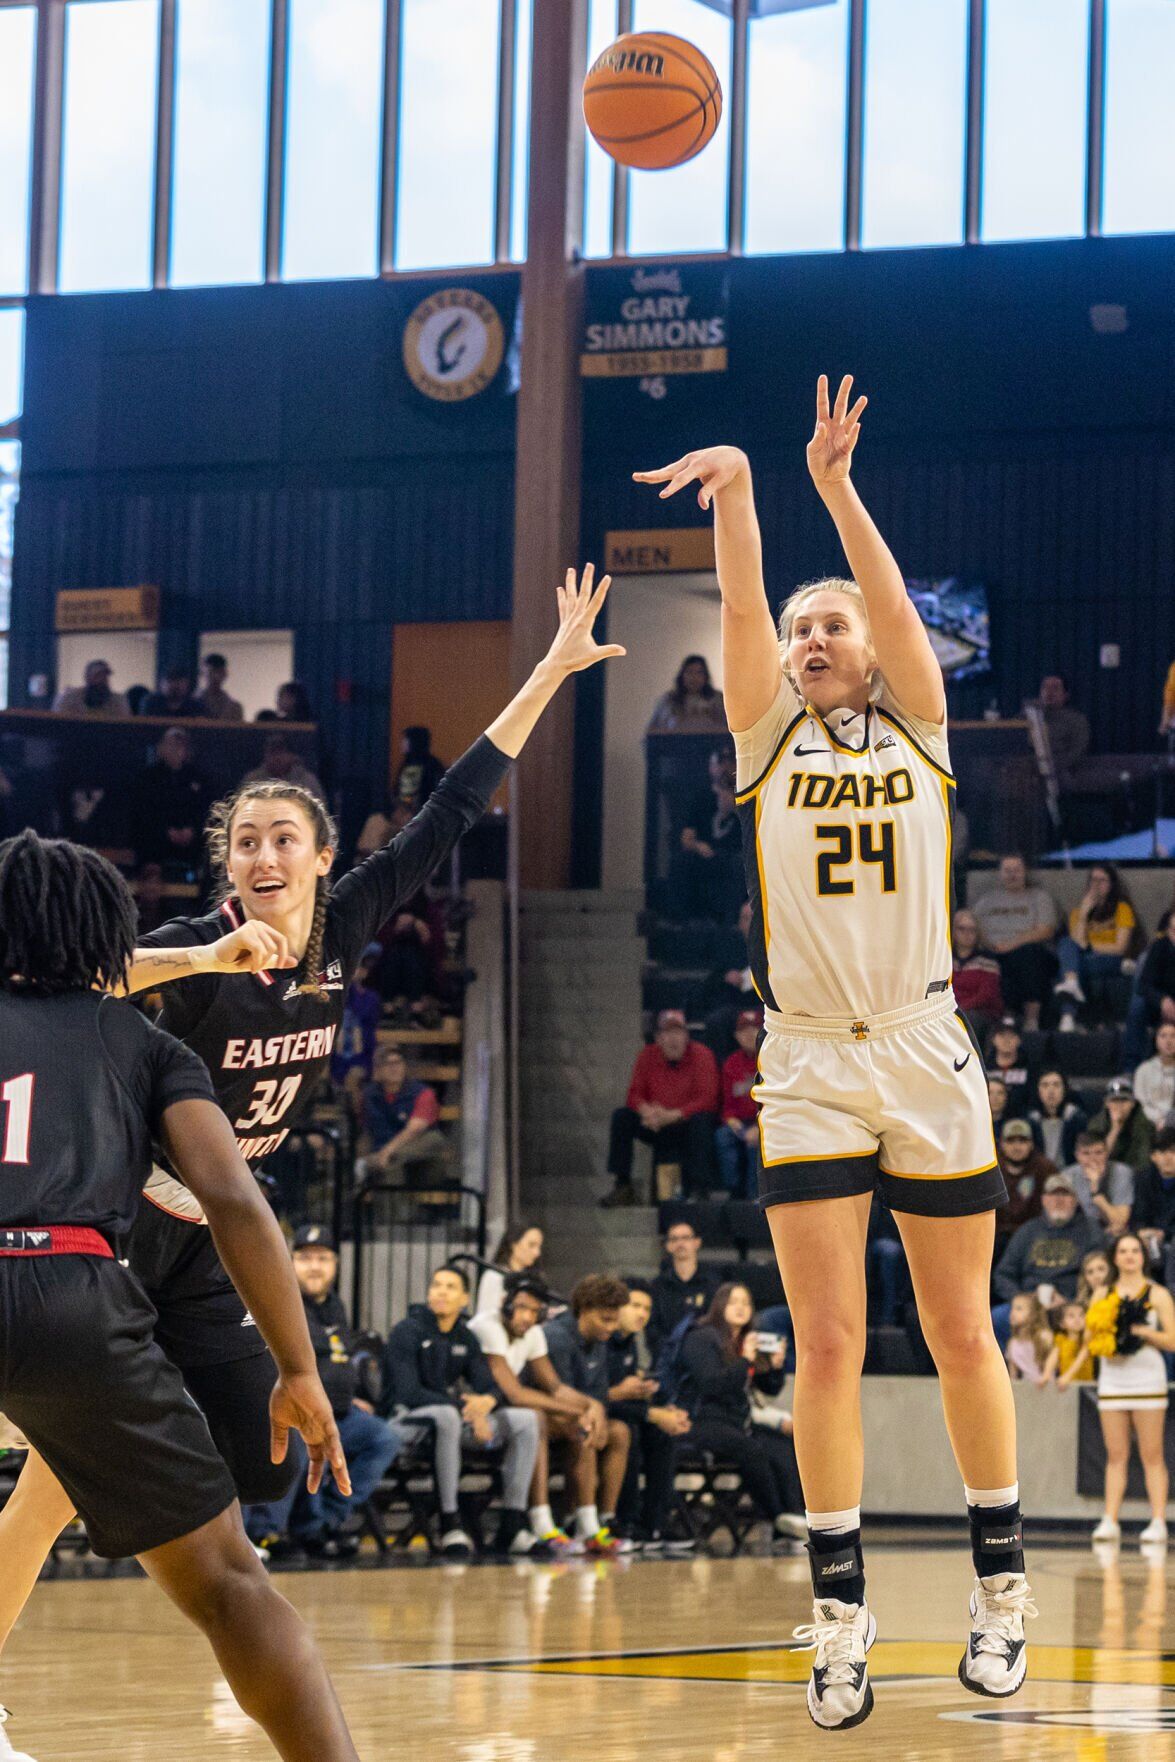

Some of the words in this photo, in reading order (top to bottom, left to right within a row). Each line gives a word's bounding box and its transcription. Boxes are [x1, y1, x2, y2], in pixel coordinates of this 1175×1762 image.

[620, 296, 690, 320] GARY
[585, 317, 725, 350] SIMMONS
[612, 547, 670, 566] MEN
[787, 768, 914, 810] IDAHO
[814, 821, 899, 897] 24
[221, 1024, 337, 1069] EASTERN
[2, 1072, 35, 1164] 1
[234, 1074, 303, 1129] 30
